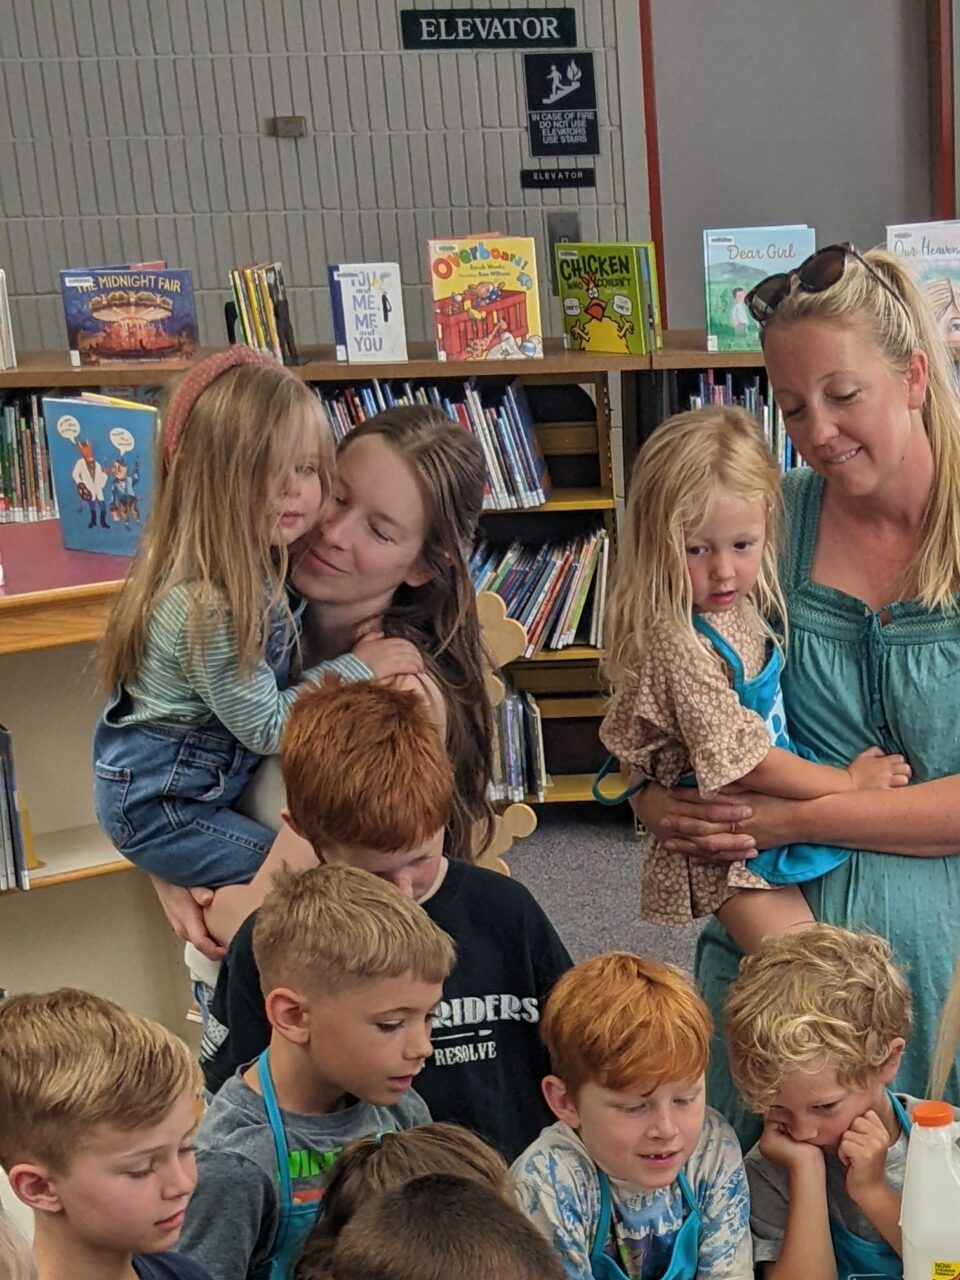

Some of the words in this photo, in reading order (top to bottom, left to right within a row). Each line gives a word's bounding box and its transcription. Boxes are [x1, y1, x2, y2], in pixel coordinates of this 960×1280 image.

[419, 17, 560, 40] ELEVATOR
[531, 113, 540, 121] IN
[542, 112, 561, 121] CASE
[564, 112, 575, 121] OF
[577, 111, 594, 120] FIRE
[540, 121, 551, 129] DO
[553, 120, 569, 129] NOT
[571, 119, 587, 128] USE
[542, 128, 586, 136] ELEVATORS
[543, 136, 558, 144] USE
[561, 135, 587, 144] STAIRS
[533, 171, 583, 180] ELEVATOR
[727, 244, 762, 260] Dear
[765, 243, 796, 260] Girl
[894, 240, 918, 256] Our
[921, 236, 960, 257] Heaven
[433, 241, 528, 280] Overboard!
[561, 254, 630, 281] CHICKEN
[98, 275, 156, 289] MIDNIGHT
[158, 277, 181, 293] FAIR
[354, 337, 383, 352] YOU
[431, 994, 540, 1029] RIDERS
[434, 1041, 497, 1066] RESOLVE
